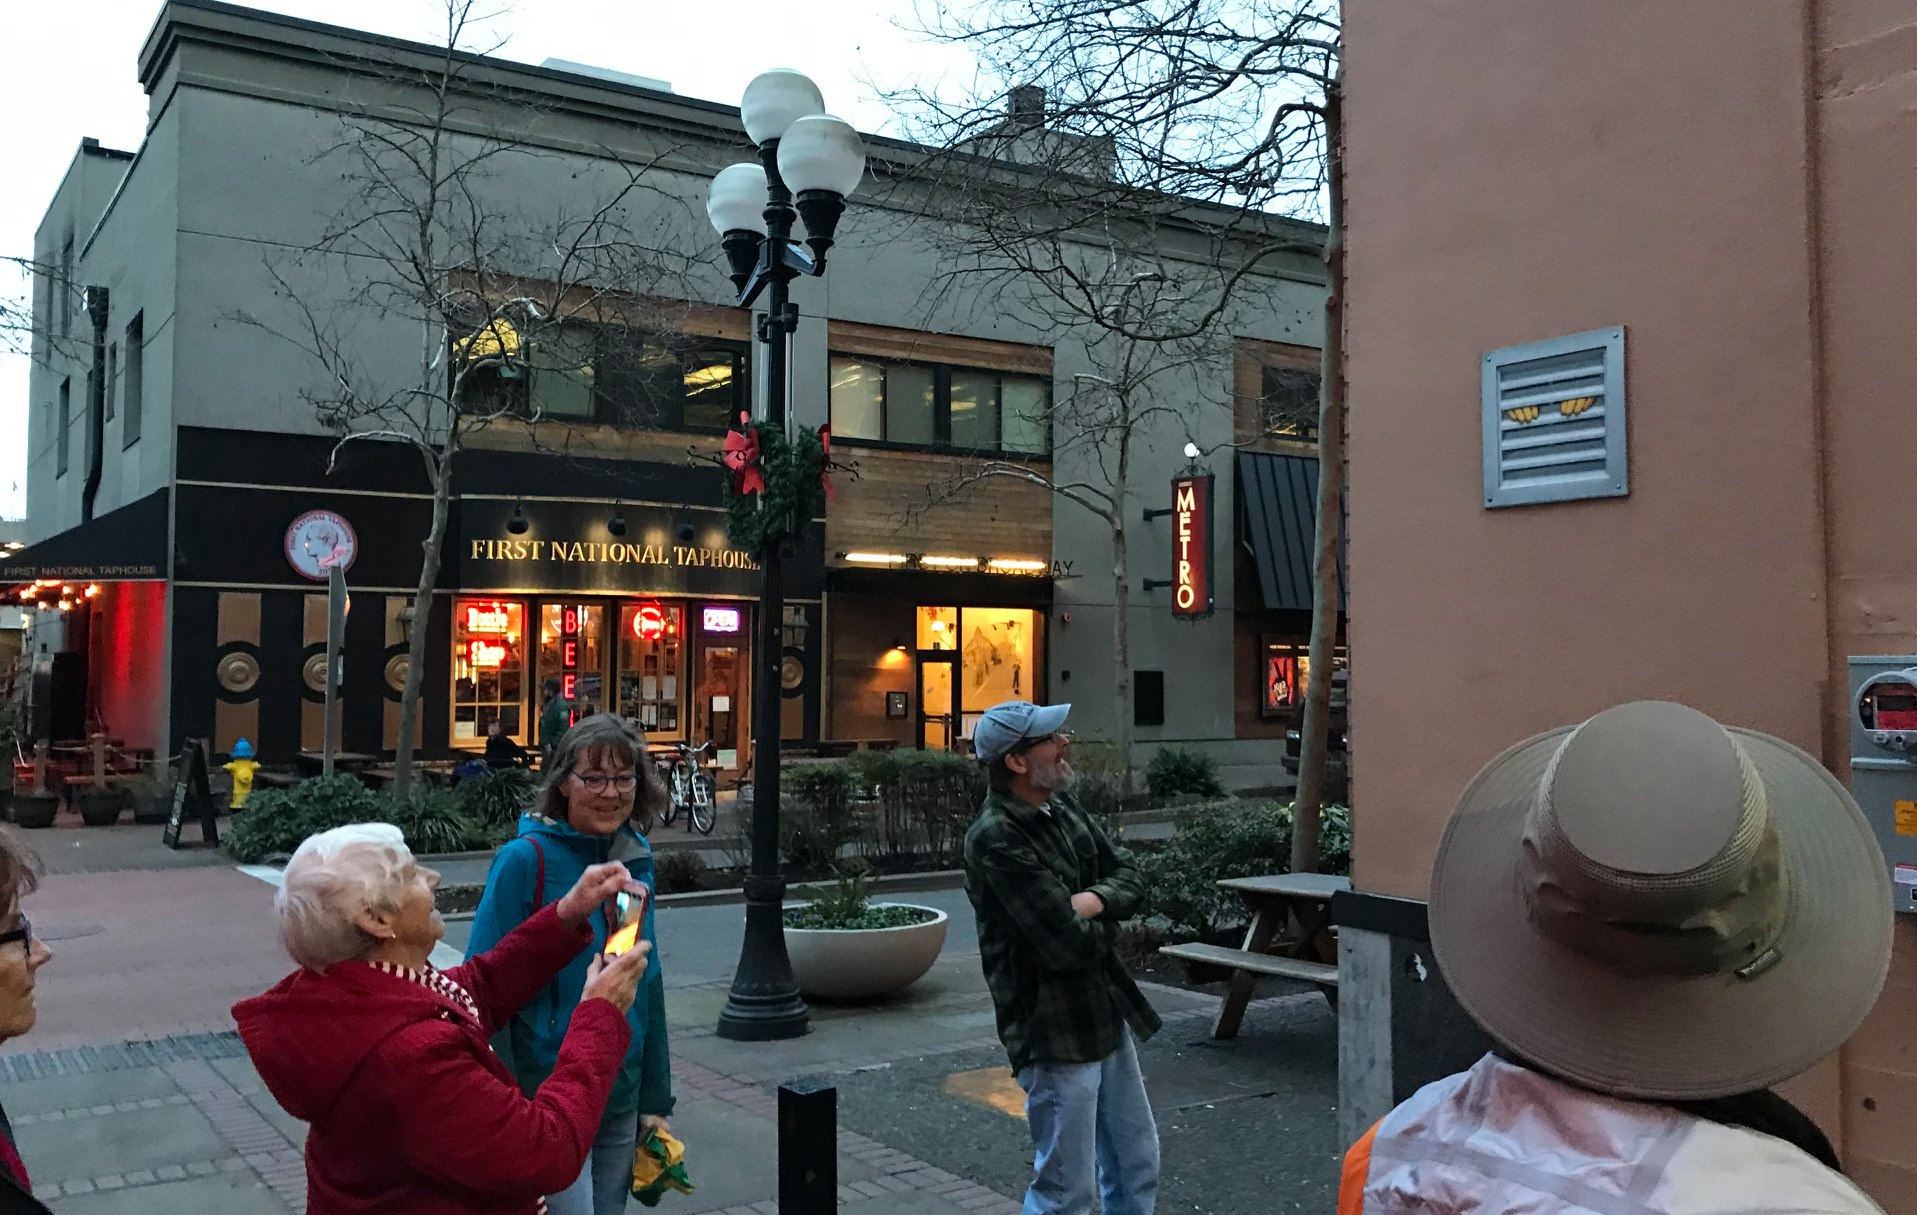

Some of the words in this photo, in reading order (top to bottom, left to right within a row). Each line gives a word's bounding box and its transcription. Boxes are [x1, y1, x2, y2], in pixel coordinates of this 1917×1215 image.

[4, 566, 37, 576] FIRST
[41, 566, 94, 576] NATIONAL
[99, 565, 157, 576] TAPHOUSE
[471, 540, 544, 560] FIRST
[551, 541, 669, 565] NATIONAL
[673, 546, 760, 571] TAPHOUS
[1177, 486, 1196, 609] METRO
[564, 609, 578, 729] BEE
